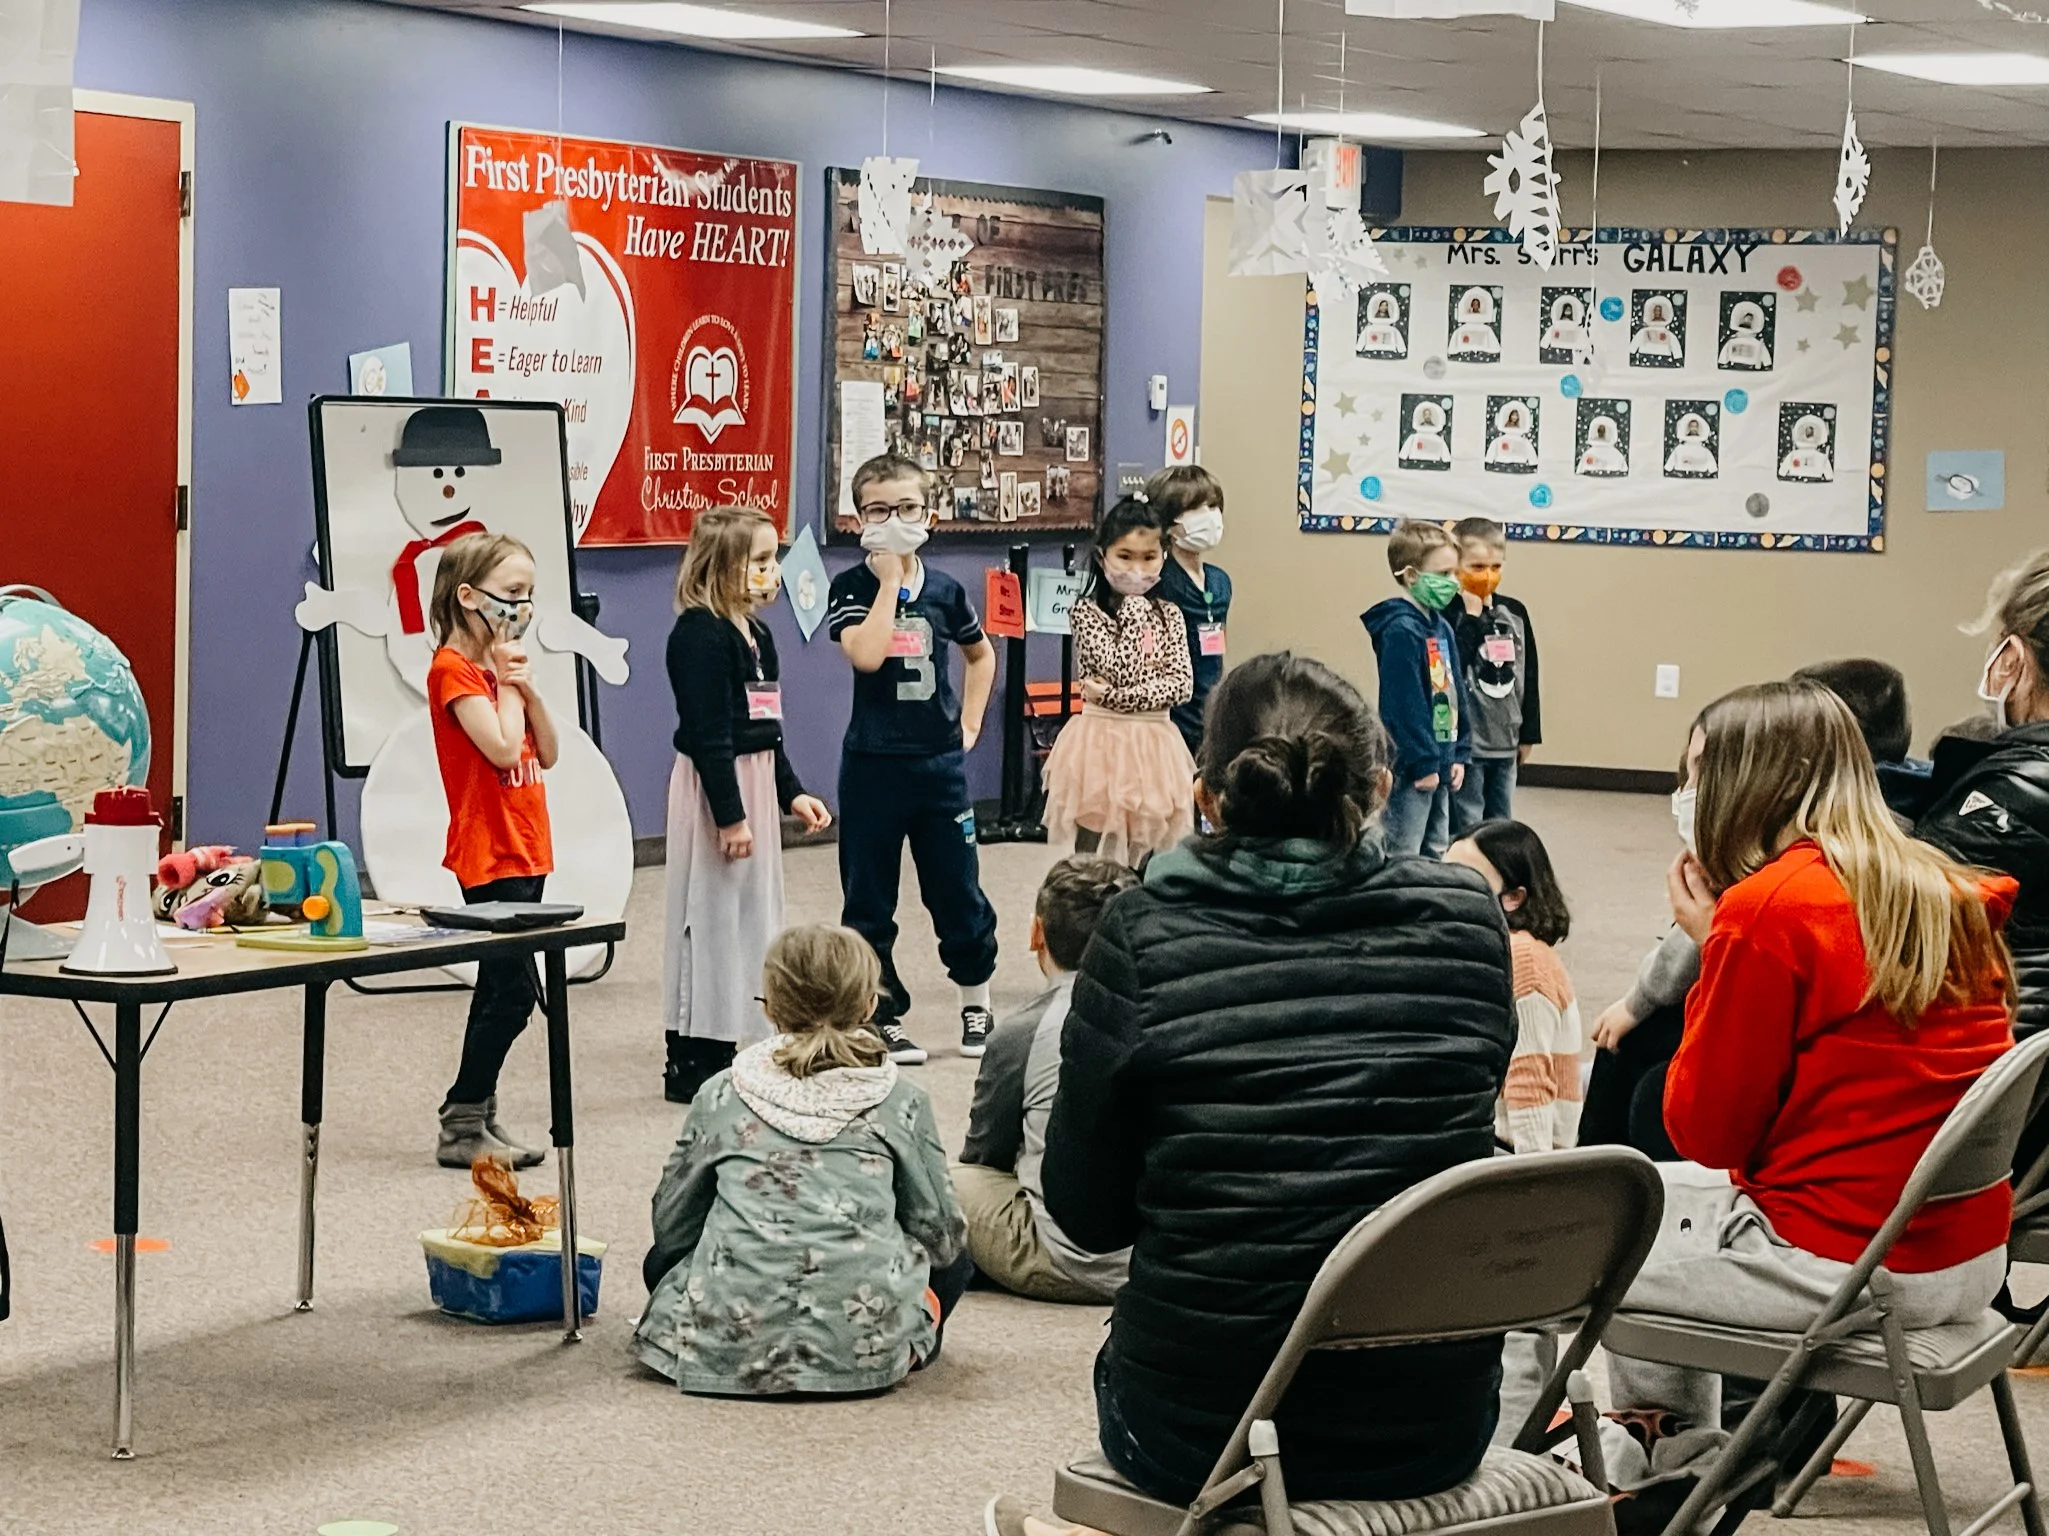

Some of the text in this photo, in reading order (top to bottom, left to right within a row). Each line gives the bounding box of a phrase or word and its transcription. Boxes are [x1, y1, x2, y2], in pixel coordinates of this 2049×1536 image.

[465, 145, 531, 193] First
[535, 152, 690, 212] Presbyterian
[694, 170, 792, 217] Students
[624, 214, 790, 268] Have HEART!
[1447, 244, 1501, 265] Mrs.
[1623, 240, 1760, 275] GALAXY
[470, 286, 496, 322] H
[510, 295, 558, 327] Helpful
[471, 338, 494, 374] E
[508, 346, 547, 377] Eager
[552, 349, 568, 373] to
[571, 349, 602, 374] Learn
[564, 398, 588, 422] Kind
[644, 446, 774, 472] FIRST PRESBYTERIAN
[641, 474, 779, 512] Christian School
